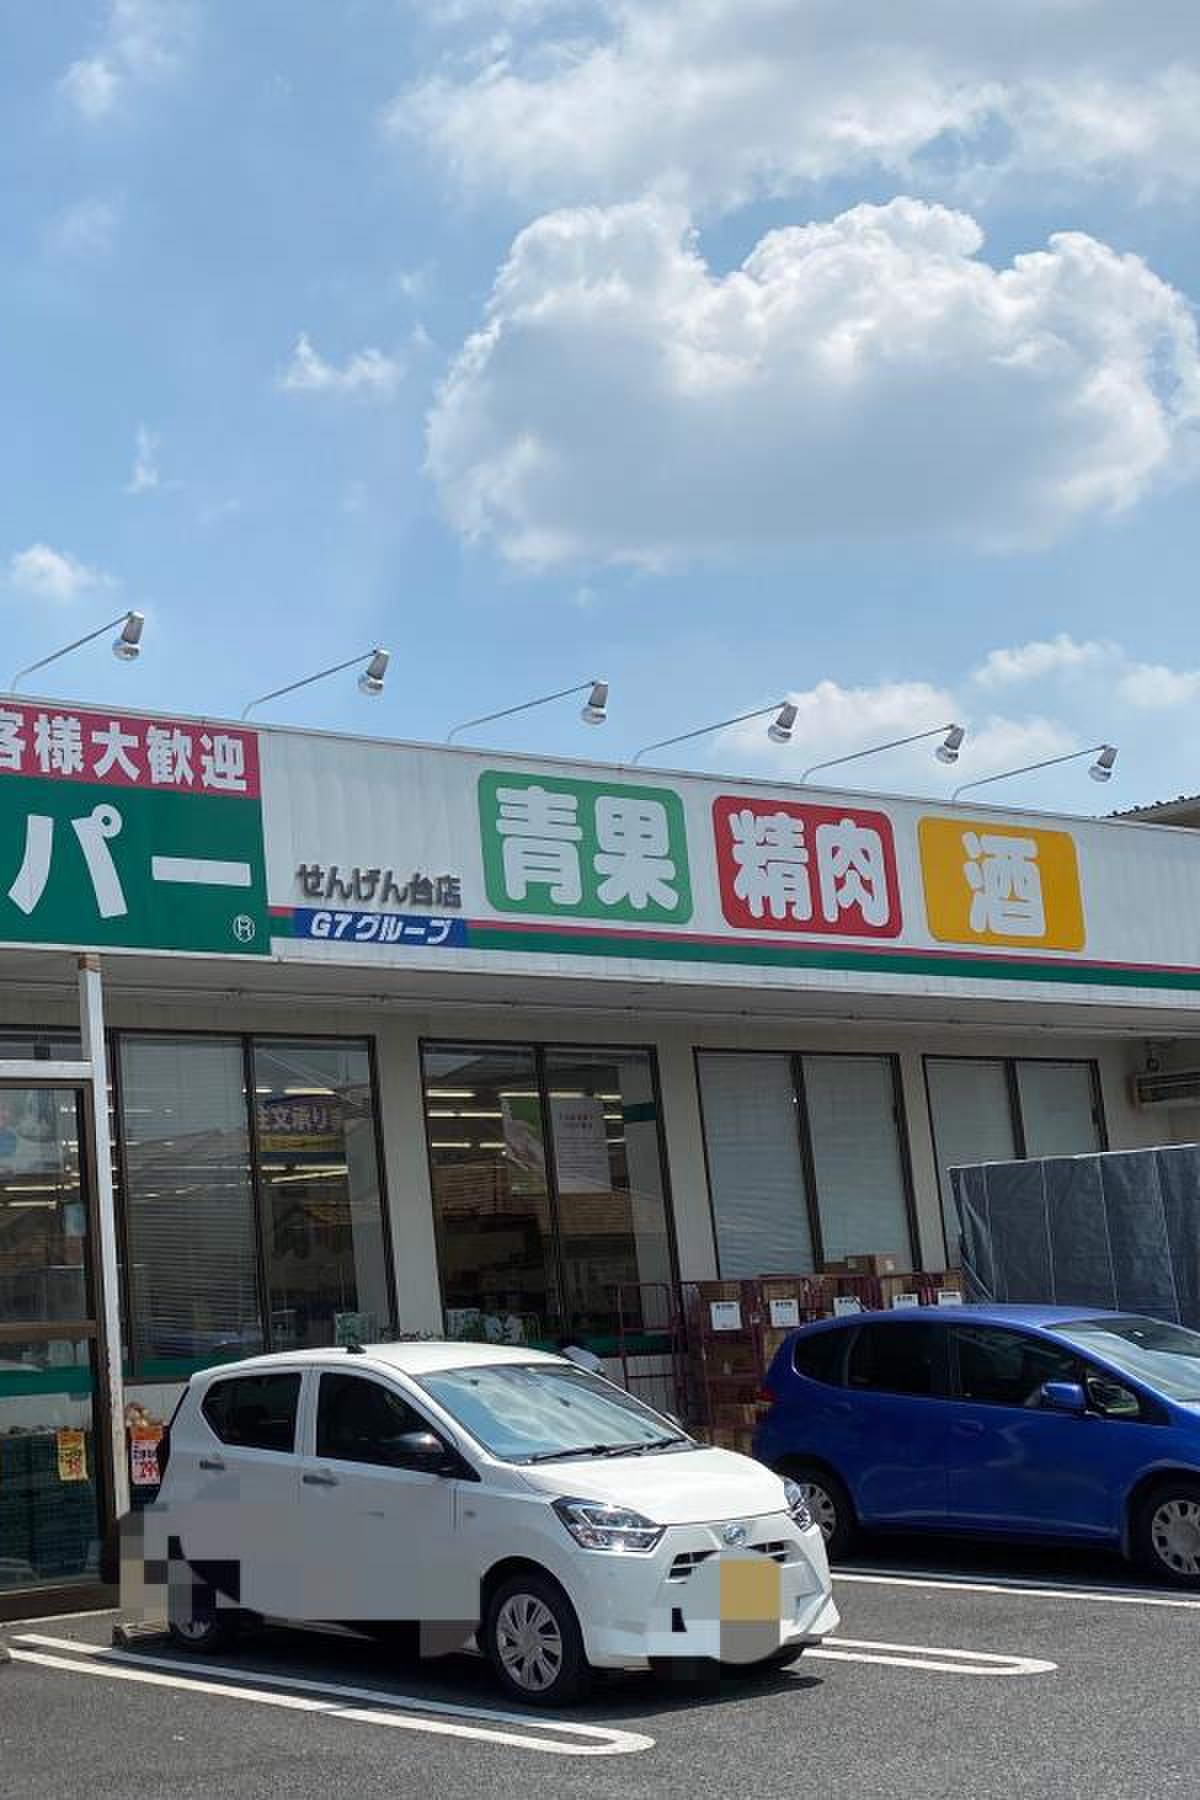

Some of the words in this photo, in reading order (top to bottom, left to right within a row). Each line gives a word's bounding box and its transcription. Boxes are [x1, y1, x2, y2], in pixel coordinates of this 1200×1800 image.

[296, 863, 462, 909] せんげん台店
[495, 785, 679, 911] 青果
[729, 809, 889, 928] 精肉
[962, 831, 1048, 938] 酒
